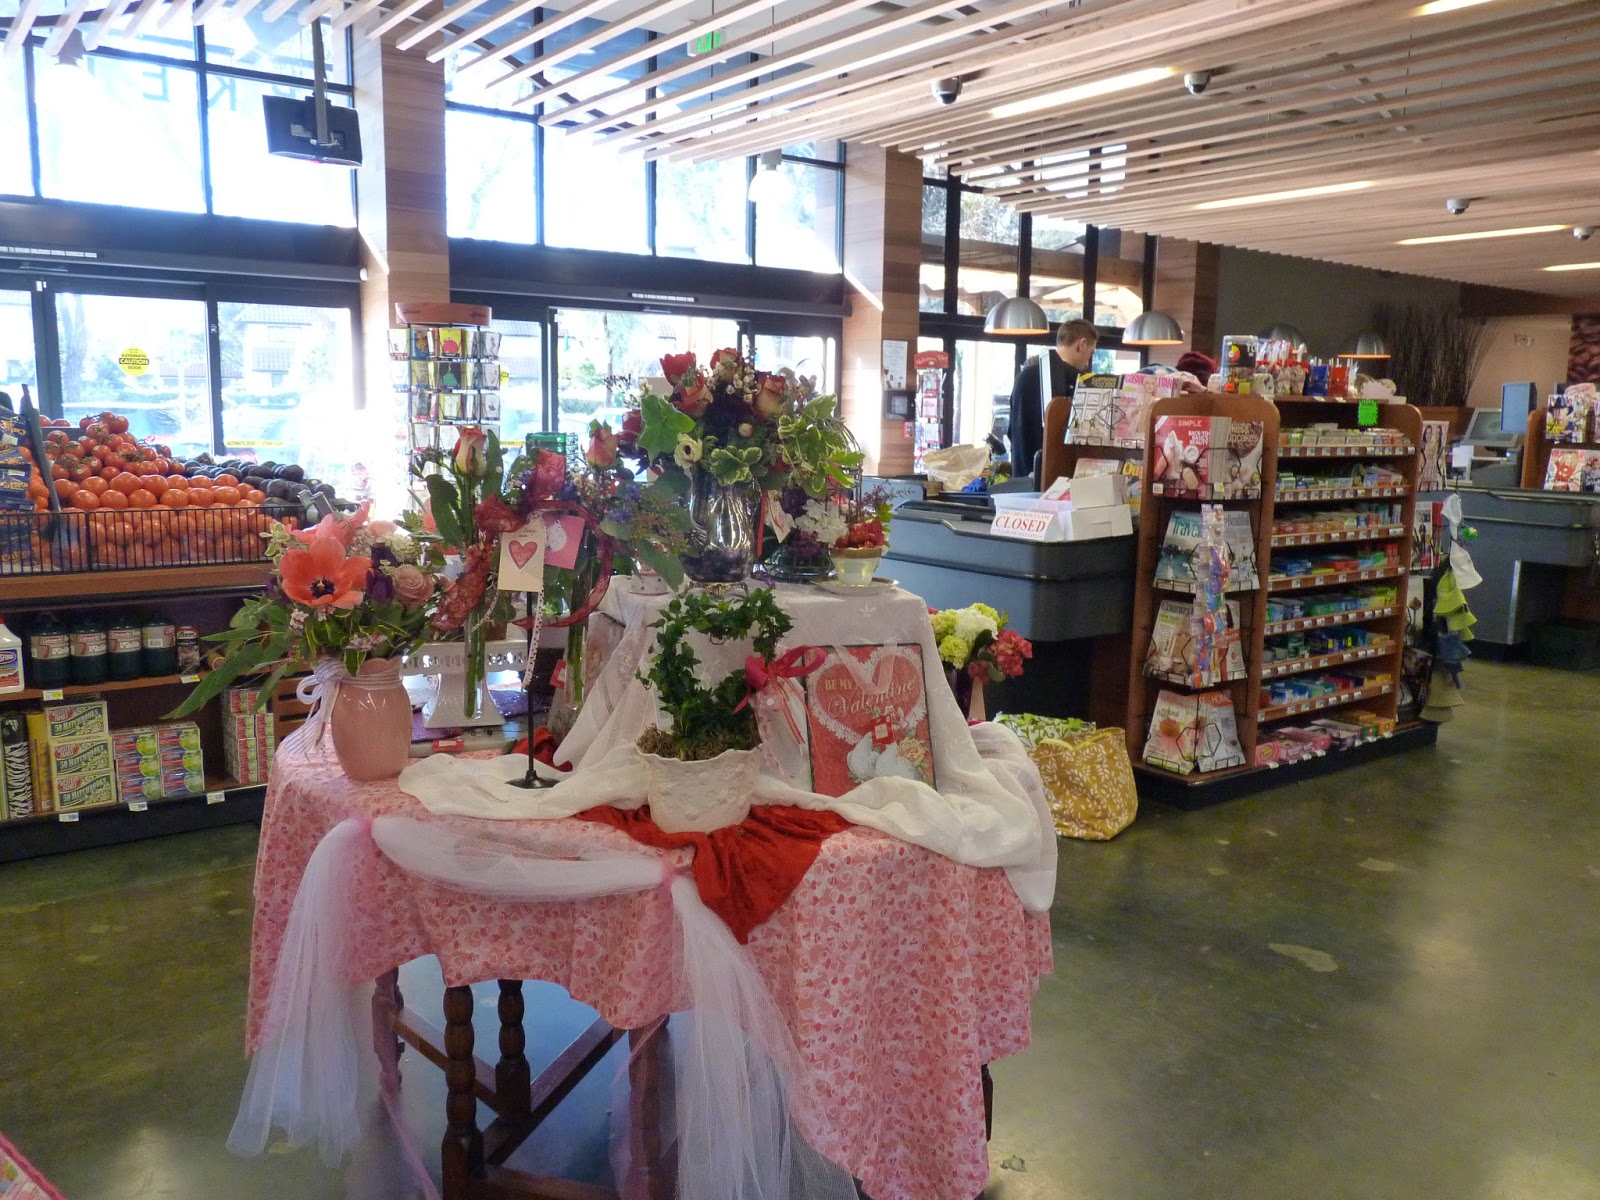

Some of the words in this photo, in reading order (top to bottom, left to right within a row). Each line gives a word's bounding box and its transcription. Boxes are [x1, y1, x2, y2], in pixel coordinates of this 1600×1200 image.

[1178, 419, 1202, 427] SIMPLE
[995, 515, 1046, 533] CLOSED
[825, 679, 837, 691] BE
[840, 679, 854, 690] MY
[827, 676, 916, 719] Valentine
